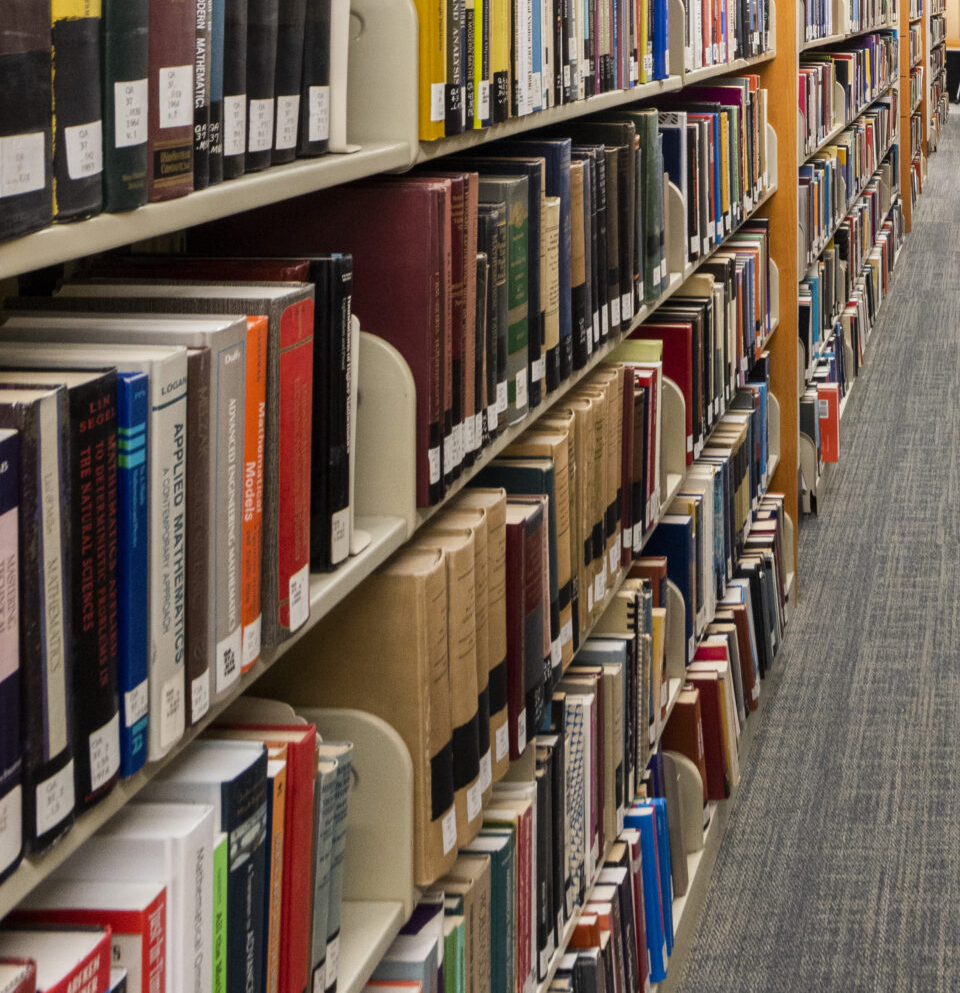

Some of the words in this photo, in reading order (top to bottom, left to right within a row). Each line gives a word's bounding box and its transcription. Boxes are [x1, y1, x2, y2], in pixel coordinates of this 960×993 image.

[452, 28, 462, 85] ANALYSIS
[79, 406, 116, 434] SEGEL
[89, 394, 111, 415] LIN
[161, 377, 187, 397] LOGAN
[80, 446, 92, 479] THE
[95, 440, 106, 460] TO
[173, 422, 184, 508] APPLIED
[228, 398, 237, 463] ADVANCED
[255, 401, 265, 514] Mathematical
[81, 480, 93, 555] NATURAL
[108, 434, 118, 570] MATHEMATICS
[161, 478, 171, 568] CONTEMPORARY
[227, 463, 237, 547] ENGINEERING
[244, 461, 257, 523] Models
[48, 554, 62, 672] MATHEMATICS
[81, 557, 95, 632] SCIENCES
[162, 573, 171, 635] APPROACH
[173, 511, 185, 664] MATHEMATICS
[227, 547, 236, 633] MATHEMATICS
